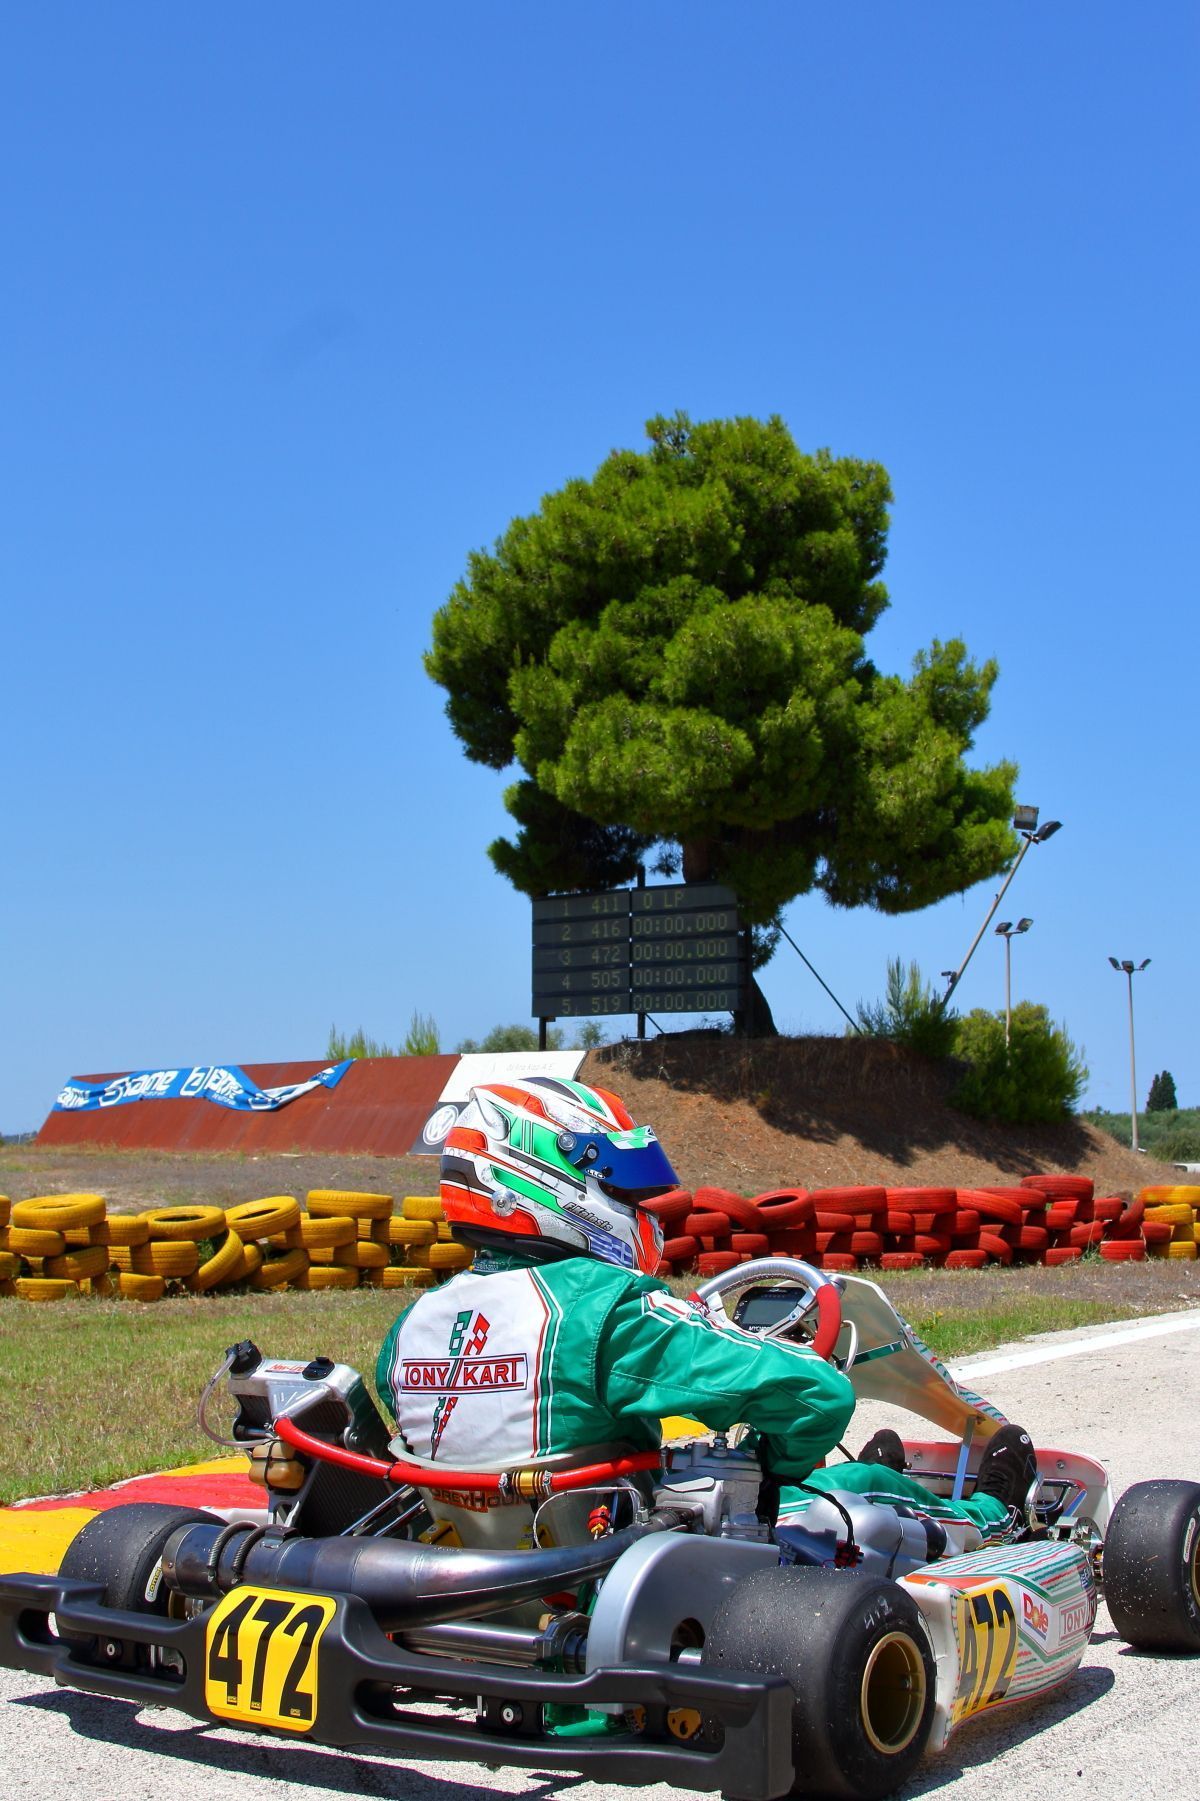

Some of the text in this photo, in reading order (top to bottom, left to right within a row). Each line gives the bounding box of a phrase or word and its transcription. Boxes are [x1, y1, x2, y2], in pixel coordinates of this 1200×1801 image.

[563, 902, 569, 916] 1
[591, 897, 619, 913] 411
[663, 891, 685, 907] LP
[562, 913, 728, 941] 2 416 00:00.000
[562, 938, 728, 966] 3 472 00:00.000
[561, 966, 728, 990] 4 505 00:00.000
[562, 999, 571, 1015] 5
[591, 996, 621, 1013] 519
[402, 1356, 525, 1387] TONY KART
[1022, 1591, 1049, 1634] Dole
[1059, 1600, 1088, 1635] TONY
[208, 1594, 326, 1721] 472
[957, 1588, 1017, 1709] 472
